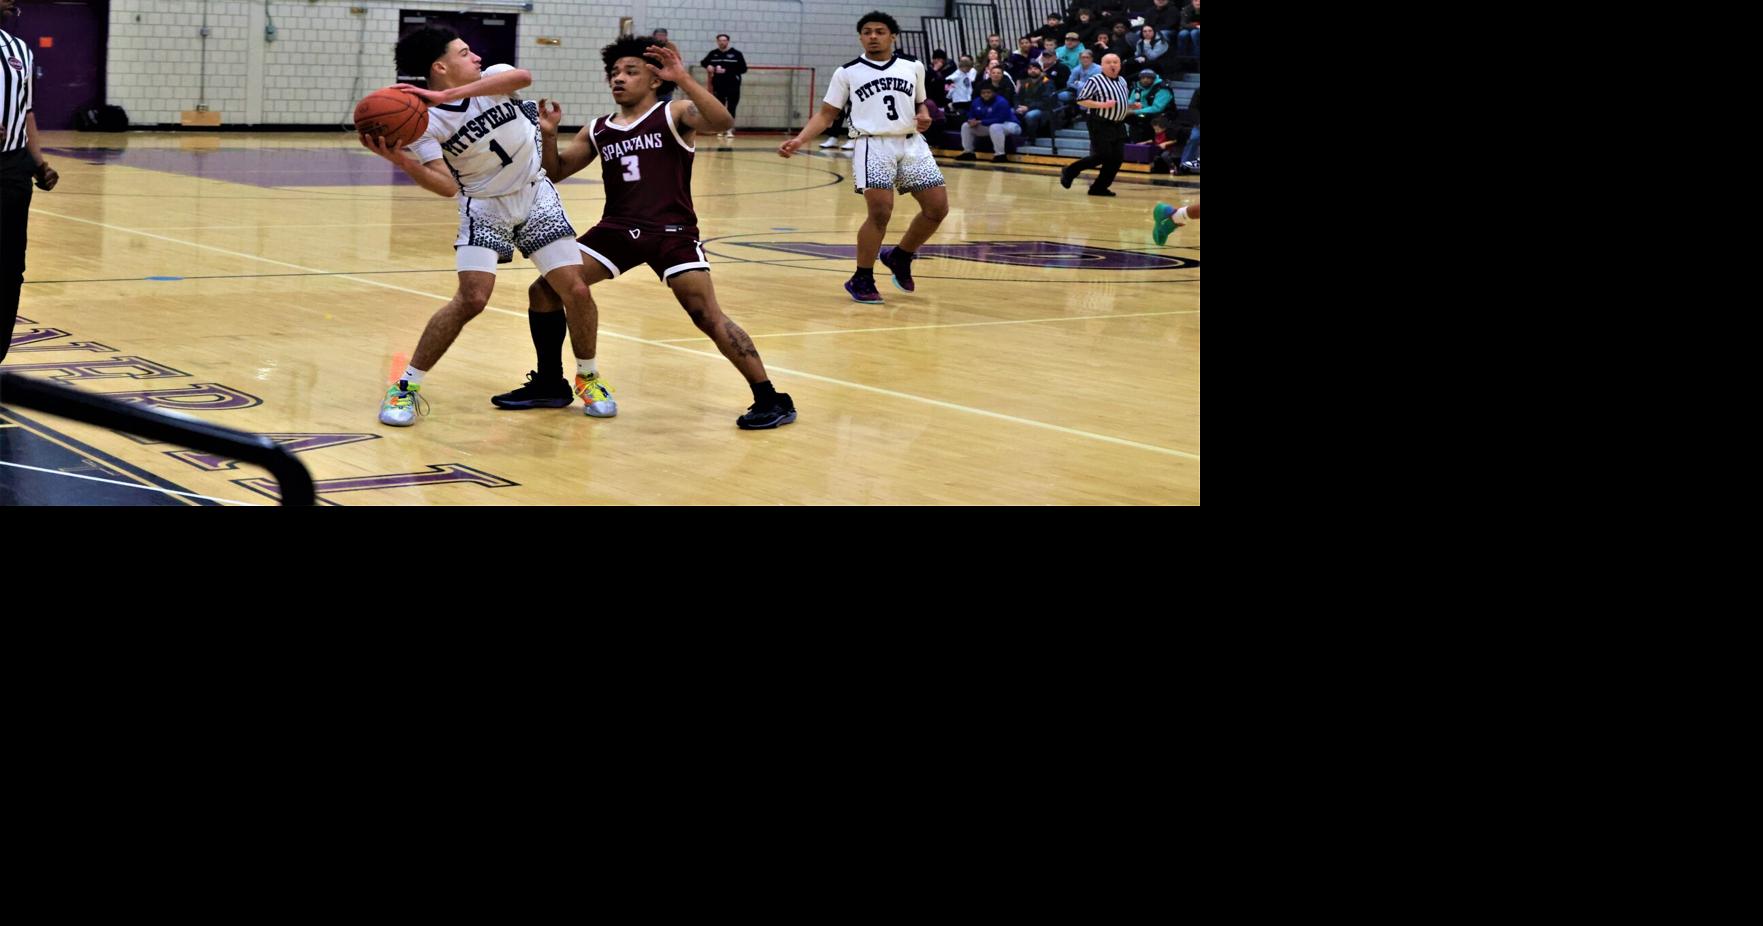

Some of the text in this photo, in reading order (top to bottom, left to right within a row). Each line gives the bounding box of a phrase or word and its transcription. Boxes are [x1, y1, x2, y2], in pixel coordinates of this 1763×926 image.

[855, 77, 914, 102] PITTSFIELD
[883, 95, 899, 121] 3
[489, 139, 513, 168] 1
[602, 133, 663, 161] SPARTANS
[620, 155, 641, 182] 3
